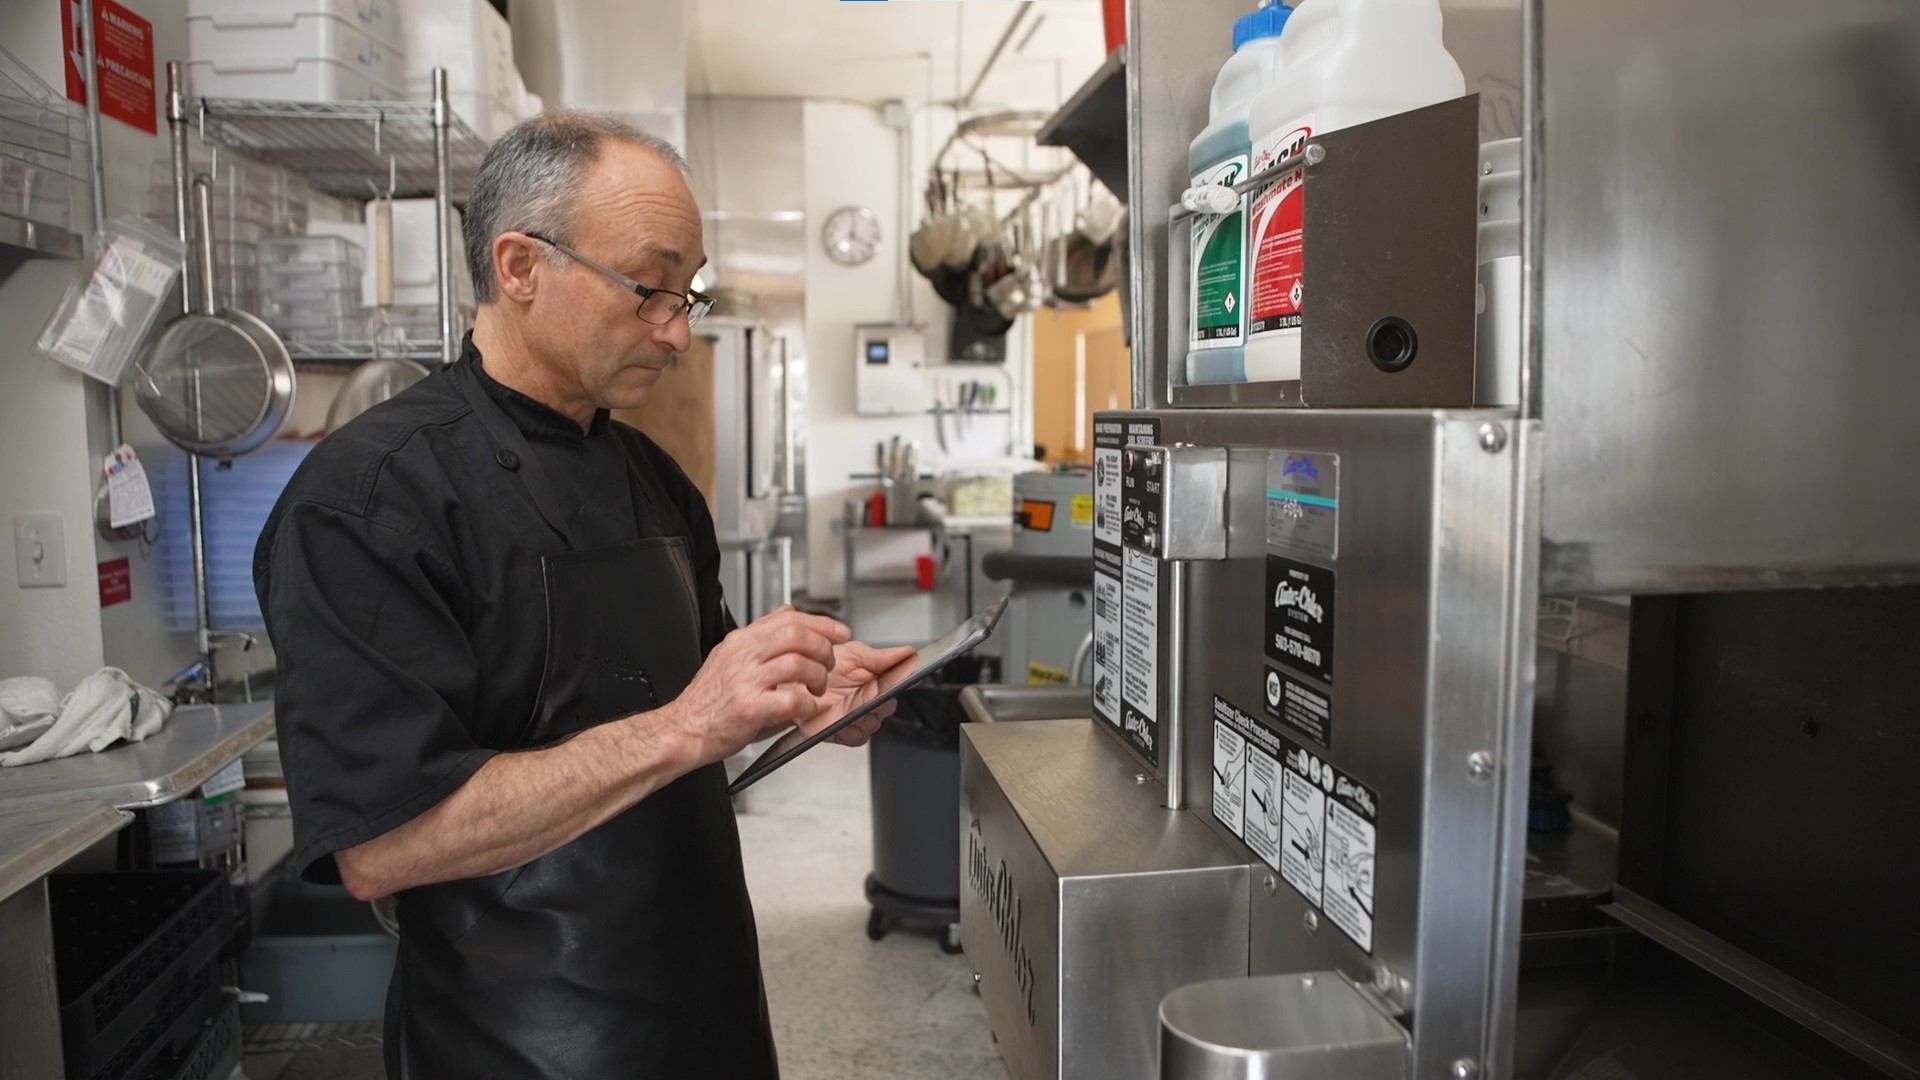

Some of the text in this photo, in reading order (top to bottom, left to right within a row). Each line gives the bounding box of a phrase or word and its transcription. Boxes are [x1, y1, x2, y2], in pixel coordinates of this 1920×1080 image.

[1125, 476, 1135, 489] RUN
[1146, 480, 1160, 495] START
[1147, 511, 1157, 525] FILL
[1287, 608, 1309, 623] SYSTEM
[1234, 709, 1250, 731] Check
[1249, 719, 1280, 750] Procedures
[1247, 746, 1253, 764] 2
[1285, 771, 1291, 791] 3
[1328, 802, 1335, 822] 4
